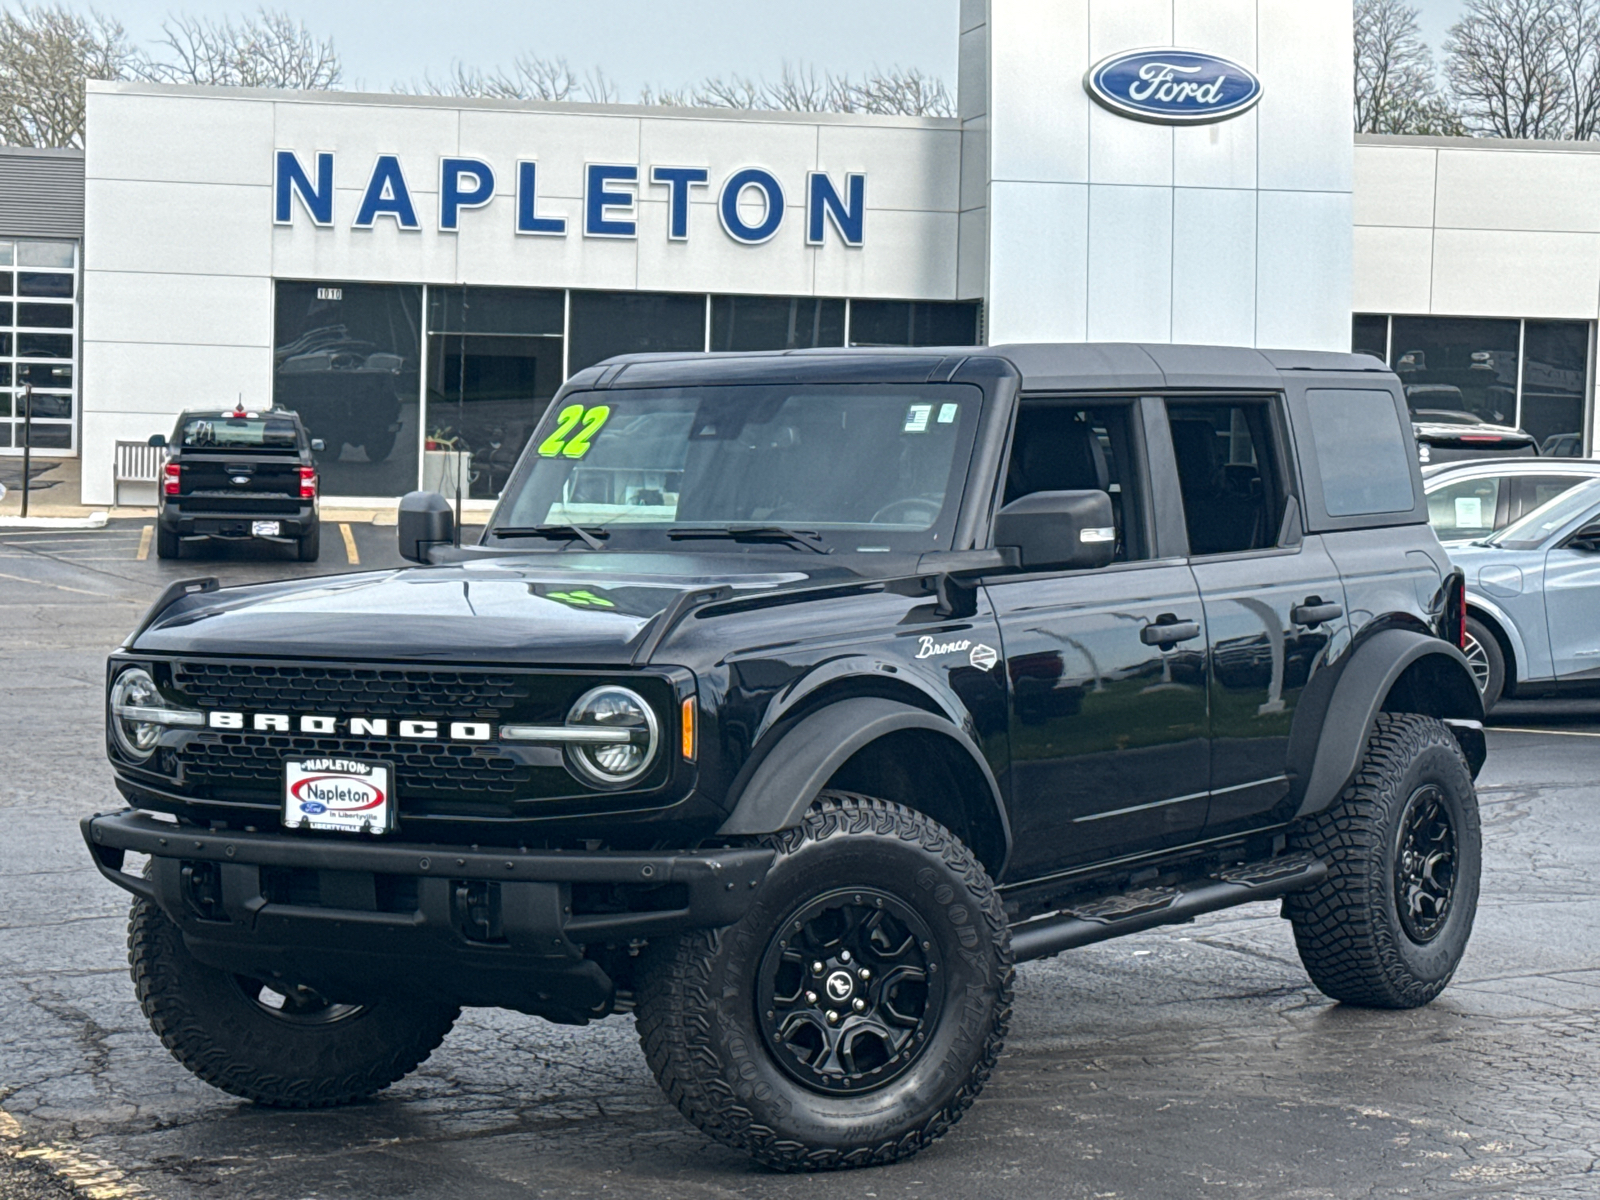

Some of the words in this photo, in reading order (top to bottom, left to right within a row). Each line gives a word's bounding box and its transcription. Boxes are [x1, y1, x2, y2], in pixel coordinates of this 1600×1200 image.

[1129, 62, 1226, 104] Ford
[273, 149, 866, 246] NAPLETON
[318, 288, 341, 300] 1010
[538, 404, 610, 458] 22
[914, 636, 971, 659] Bronco
[209, 711, 491, 740] BRONCO
[307, 759, 366, 774] NAPLETON
[306, 781, 370, 804] Napleton
